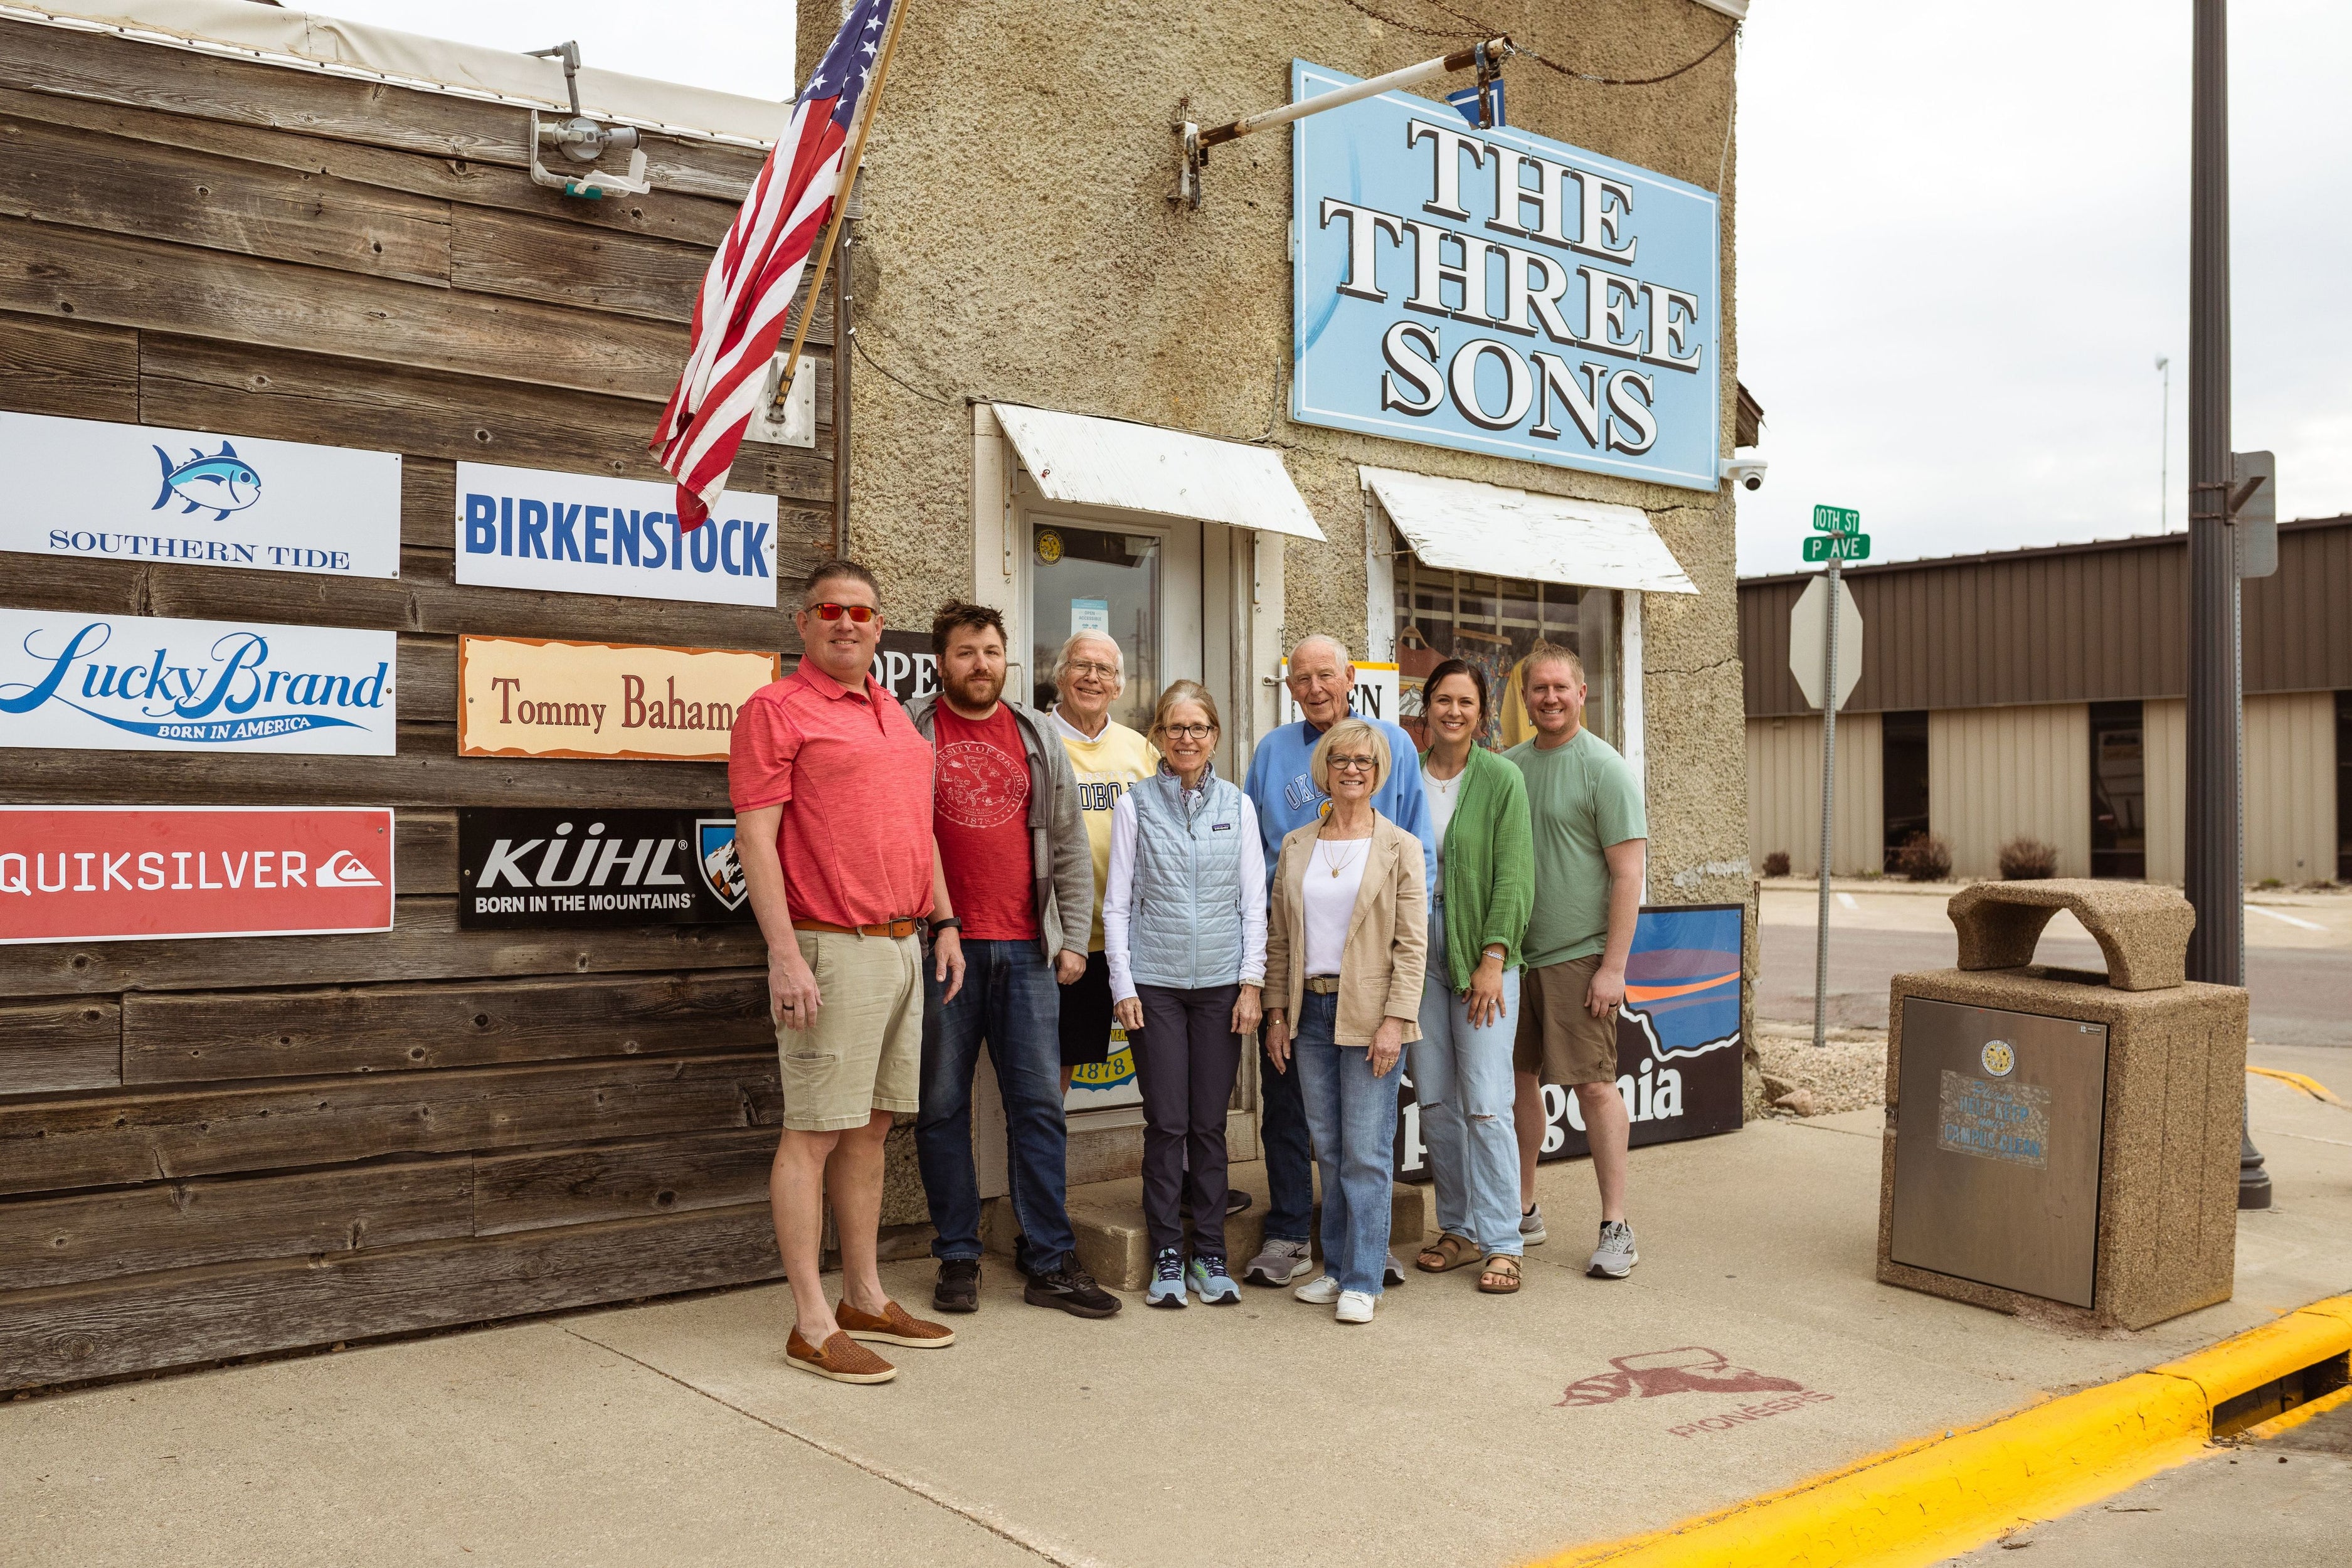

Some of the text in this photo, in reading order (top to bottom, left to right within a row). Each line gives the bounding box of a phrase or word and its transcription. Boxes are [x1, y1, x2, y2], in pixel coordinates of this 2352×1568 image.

[1407, 117, 1638, 267] THE
[1319, 197, 1702, 375] THREE
[1382, 319, 1658, 456] SONS
[465, 493, 770, 578] BIRKENSTOCK
[1815, 507, 1858, 532] 10TH ST
[50, 529, 350, 570] SOUTHERN TIDE
[1812, 537, 1860, 558] P AVE
[0, 623, 388, 719] Lucky Brand
[492, 674, 746, 734] Tommy Baham
[157, 716, 311, 739] BORN IN AMERICA
[975, 745, 994, 755] OF
[997, 754, 1025, 803] OKOBOJI
[965, 816, 991, 825] 1878
[0, 850, 307, 896] QUIKSILVER
[475, 822, 686, 888] KÜHL
[475, 893, 691, 913] BORN IN THE MOUNTAINS
[1076, 1058, 1125, 1079] 1878
[1959, 1096, 2029, 1123] HELP KEEP
[1945, 1123, 1995, 1148] CAMPUS
[1999, 1135, 2040, 1158] CLEAN
[1666, 1390, 1836, 1439] PIONEERS
